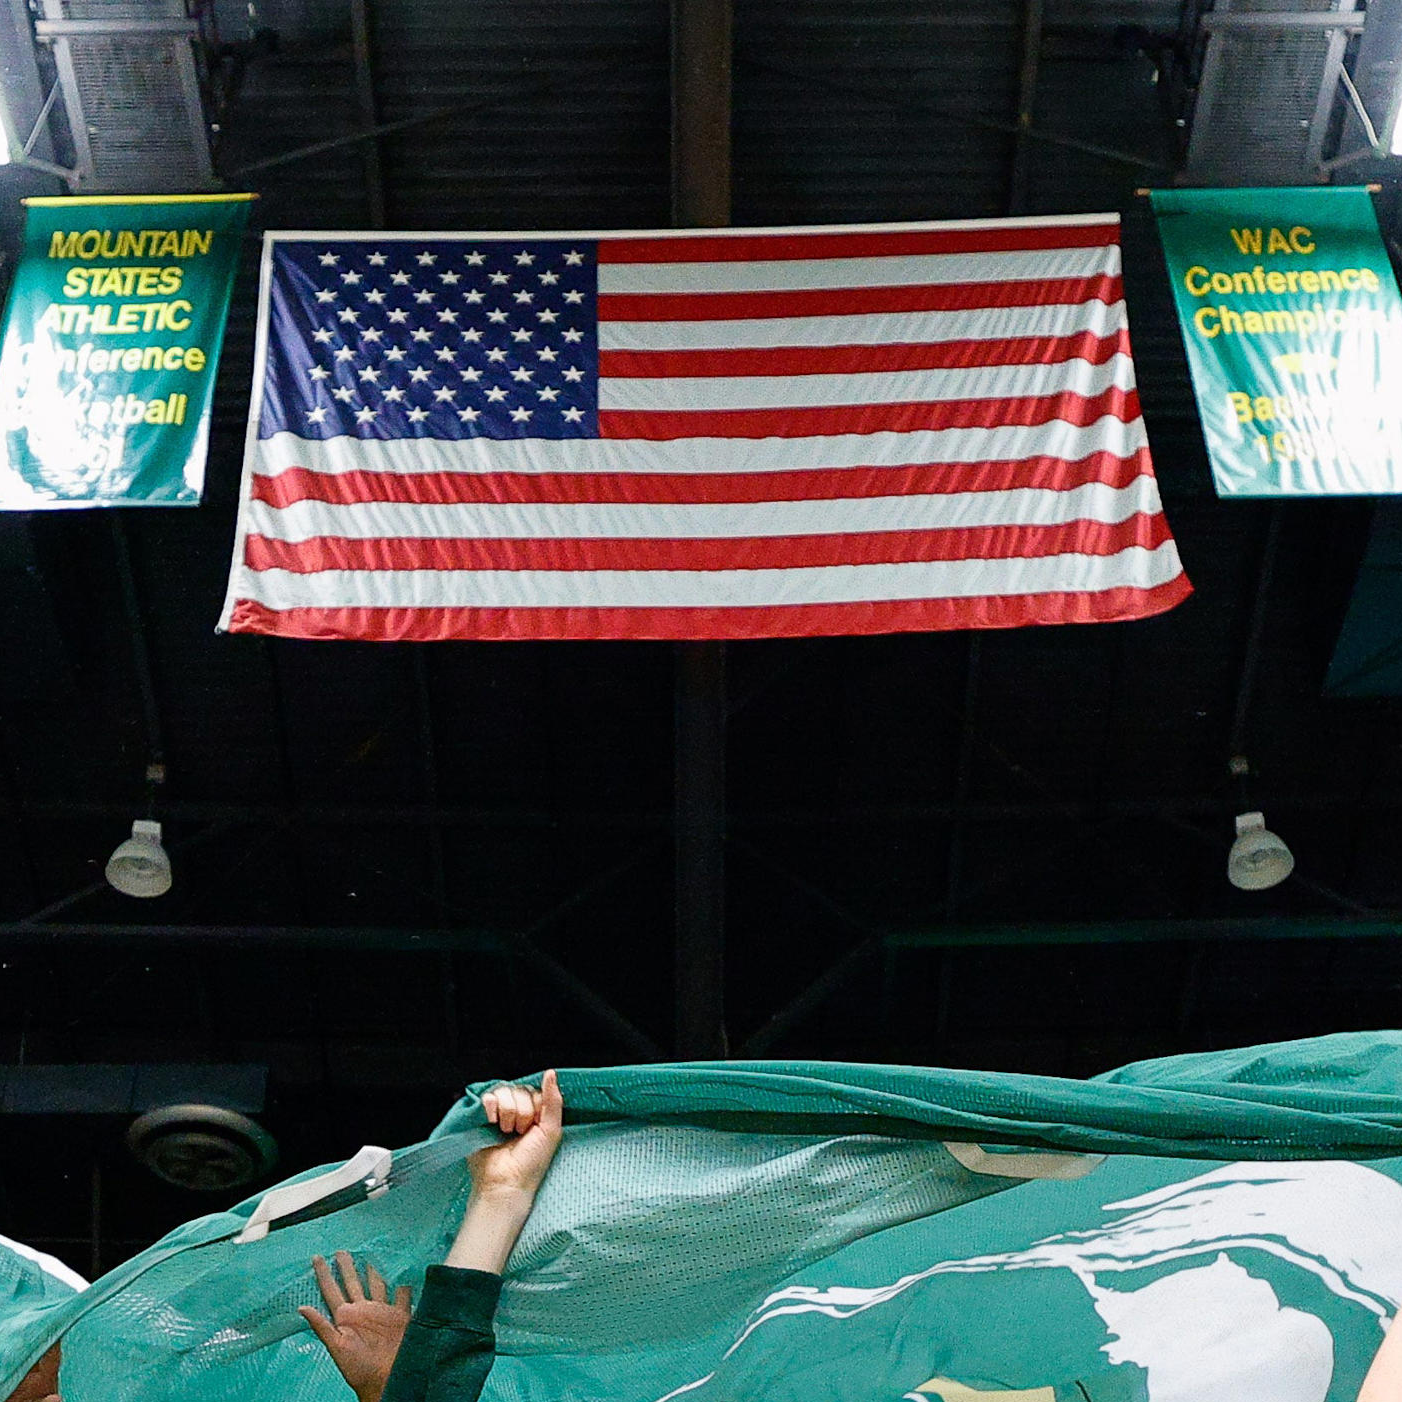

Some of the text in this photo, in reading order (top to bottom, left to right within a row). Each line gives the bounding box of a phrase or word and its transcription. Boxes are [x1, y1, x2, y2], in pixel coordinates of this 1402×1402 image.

[48, 230, 213, 259] MOUNTAIN
[1230, 226, 1316, 255] WAC
[63, 267, 184, 298] STATES
[1184, 265, 1380, 297] Conference
[47, 300, 193, 334] ATHLETIC
